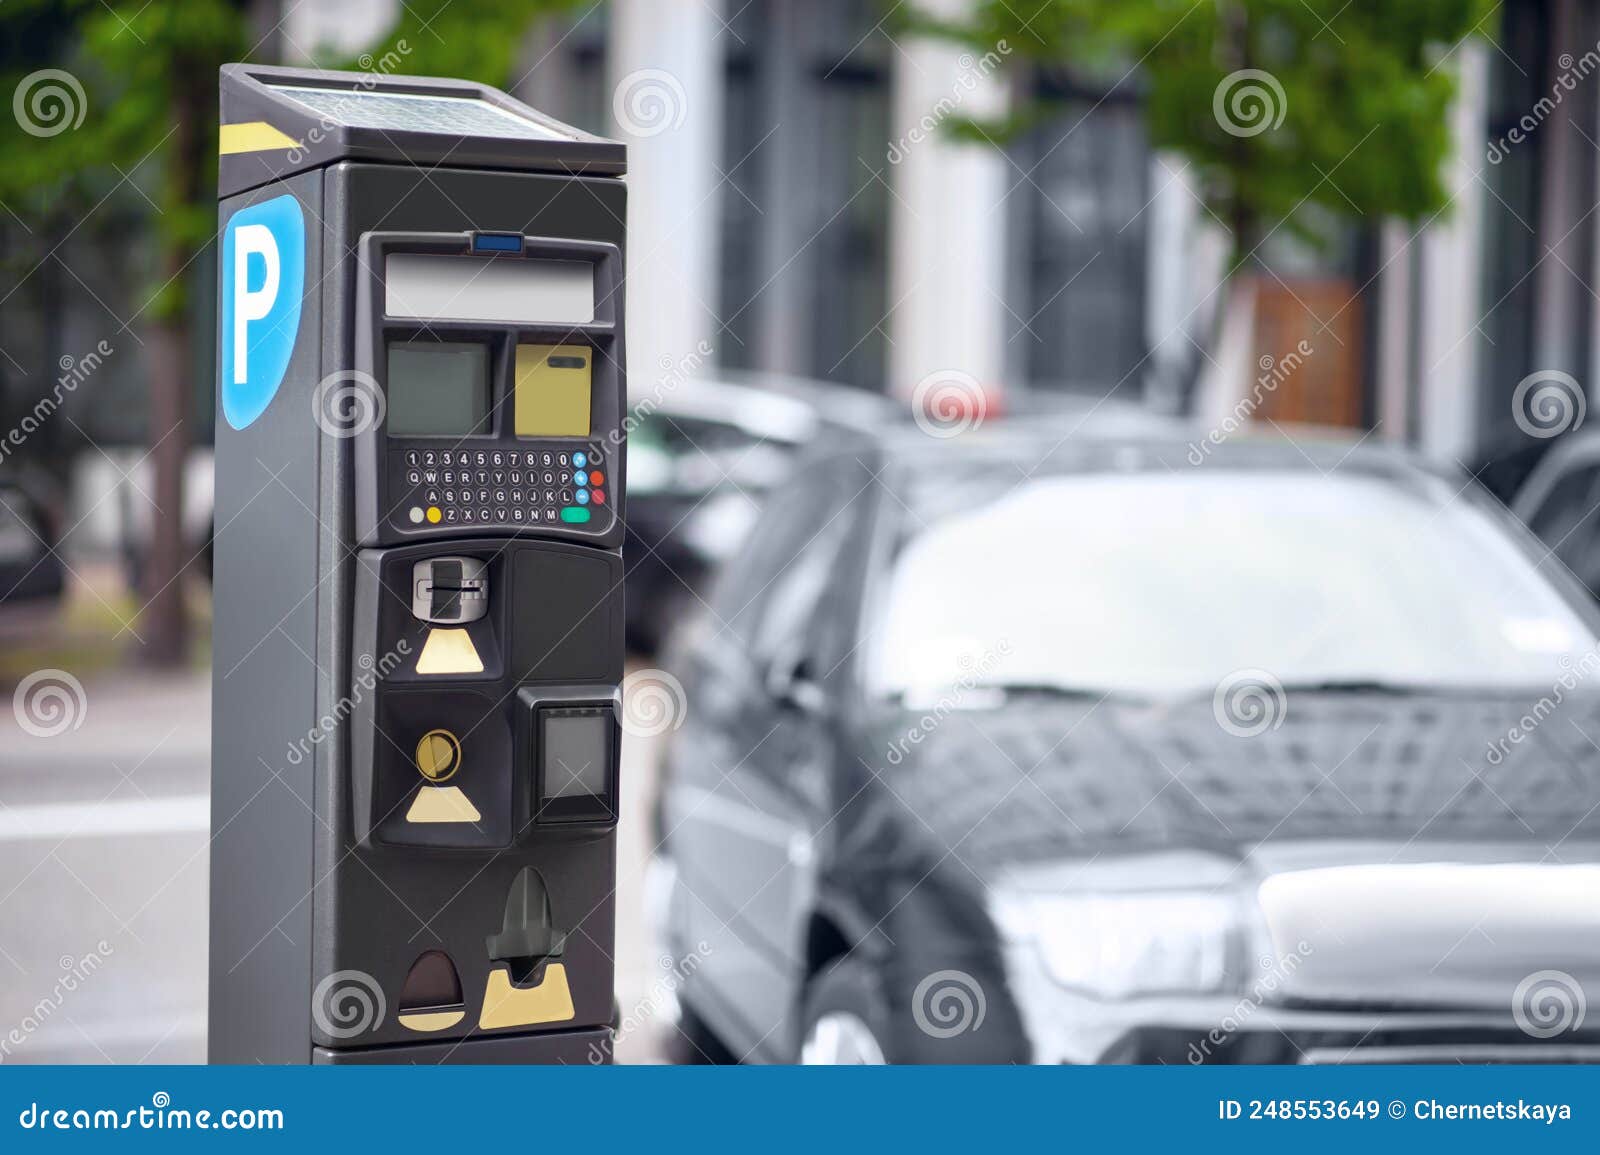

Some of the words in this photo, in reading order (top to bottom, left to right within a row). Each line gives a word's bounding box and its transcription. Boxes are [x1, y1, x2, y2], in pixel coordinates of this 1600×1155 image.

[234, 224, 280, 384] P
[426, 453, 434, 464] 2
[444, 453, 451, 464] 3
[460, 454, 468, 464] 4
[477, 454, 484, 465] 5
[494, 454, 501, 465] 6
[510, 454, 517, 465] 7
[527, 454, 534, 465] 8
[543, 454, 550, 465] 9
[410, 473, 419, 483] Q
[426, 472, 437, 482] W
[445, 473, 452, 482] E
[462, 473, 469, 482] R
[478, 473, 485, 482] T
[495, 473, 502, 482] Y
[512, 473, 519, 483] U
[561, 474, 568, 483] P
[429, 491, 437, 501] A
[446, 491, 453, 501] S
[463, 491, 471, 501] D
[480, 491, 487, 501] F
[496, 491, 504, 501] G
[513, 492, 521, 501] H
[546, 492, 554, 501] K
[563, 492, 570, 501] L
[448, 510, 455, 520] Z
[464, 510, 472, 520] X
[481, 510, 488, 520] C
[497, 510, 505, 520] V
[514, 510, 522, 519] B
[531, 510, 539, 520] N
[547, 510, 555, 519] M
